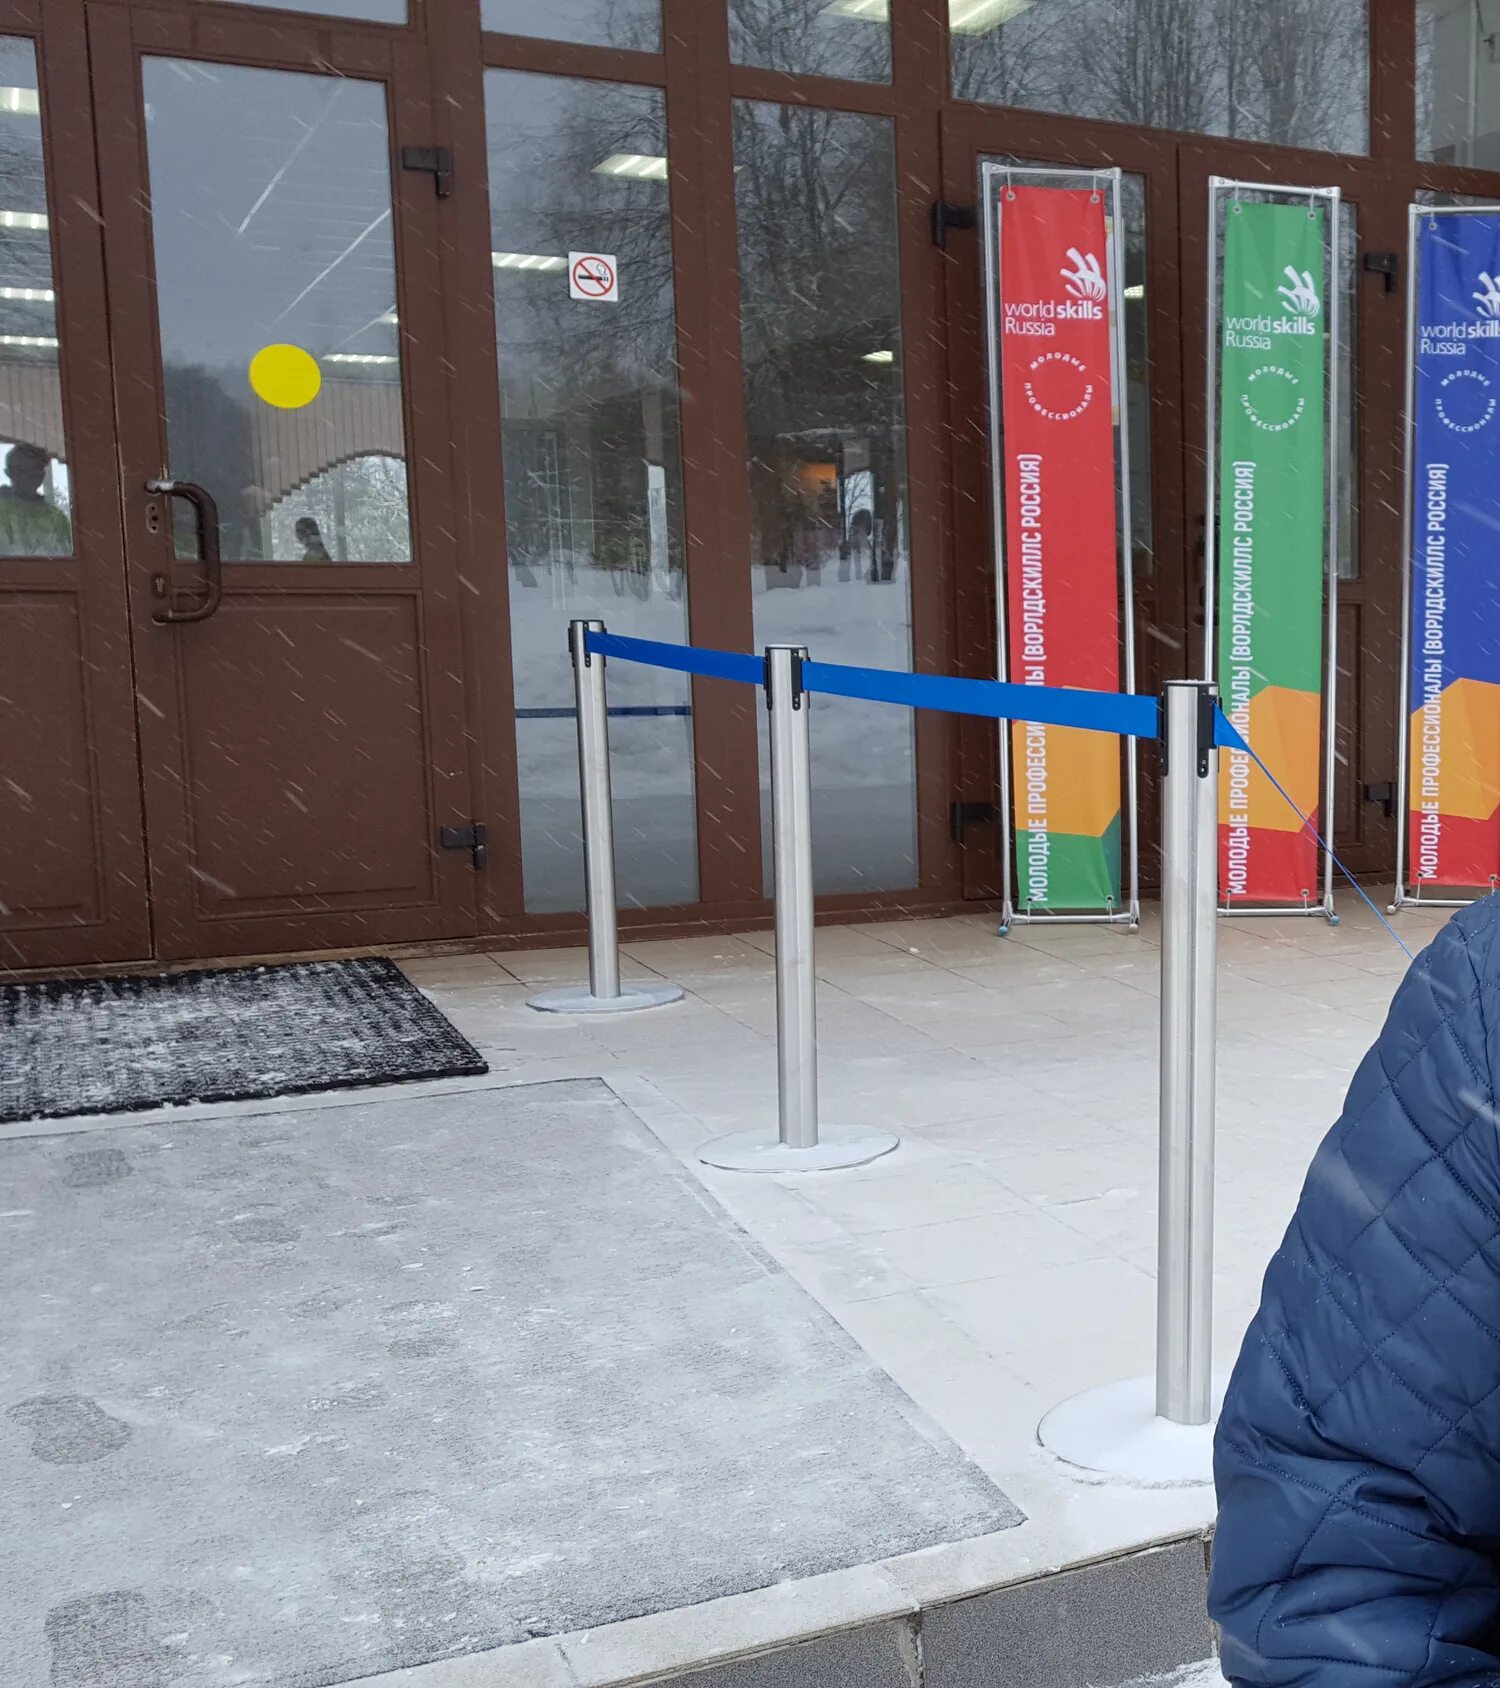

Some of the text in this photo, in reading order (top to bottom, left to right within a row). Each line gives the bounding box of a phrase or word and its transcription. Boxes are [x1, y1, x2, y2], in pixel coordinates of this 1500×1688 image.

[1005, 317, 1056, 336] Russia
[1226, 331, 1271, 350] Russia
[1030, 352, 1087, 372] МОЛОДЫЕ
[1420, 338, 1466, 355] Russia
[1248, 366, 1299, 385] МОЛОДЫЕ
[1440, 369, 1491, 387] МОЛОДЫЕ
[1024, 382, 1093, 421] ПРОФЕССИОНАЛЫ
[1241, 394, 1305, 432] ПРОФЕССИОНАЛЫ
[1435, 398, 1496, 433] ПРОФЕССИОНАЛЫ
[1017, 453, 1043, 528] РОССИЯ)
[1232, 461, 1257, 532] РОССИЯ)
[1021, 531, 1047, 661] (ВОРЛДСКИЛЛС
[1229, 536, 1254, 661] (ВОРЛДСКИЛЛС
[1420, 463, 1450, 879] МОЛОДЫЕ ПРОФЕССИОНАЛЫ (ВОРЛДСКИЛЛС РОССИЯ)
[1028, 818, 1050, 902] МОЛОДЫЕ
[1228, 813, 1250, 895] МОЛОДЫЕ
